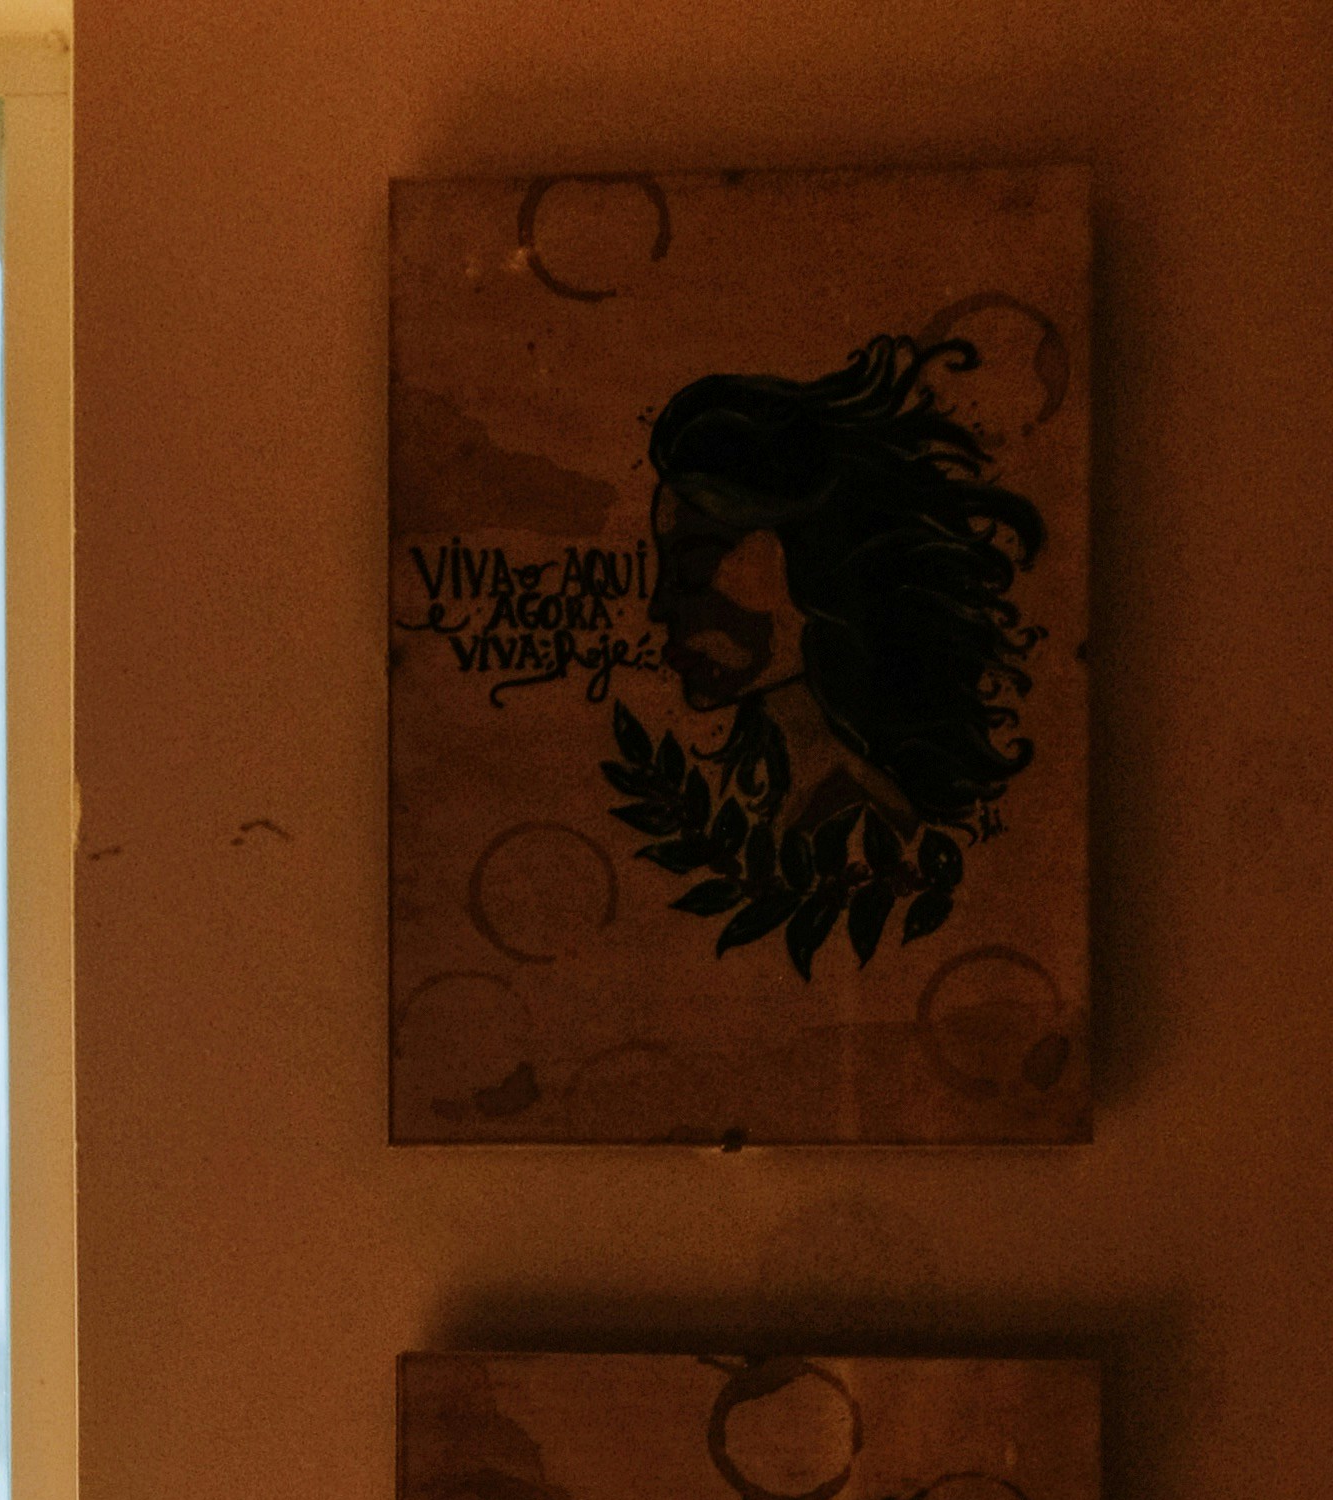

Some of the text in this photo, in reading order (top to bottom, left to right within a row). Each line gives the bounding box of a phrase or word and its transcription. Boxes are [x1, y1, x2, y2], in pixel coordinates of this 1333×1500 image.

[409, 536, 515, 598] VIVA
[557, 539, 647, 599] AQUI
[483, 592, 614, 634] AGORA
[449, 632, 543, 672] VIVA
